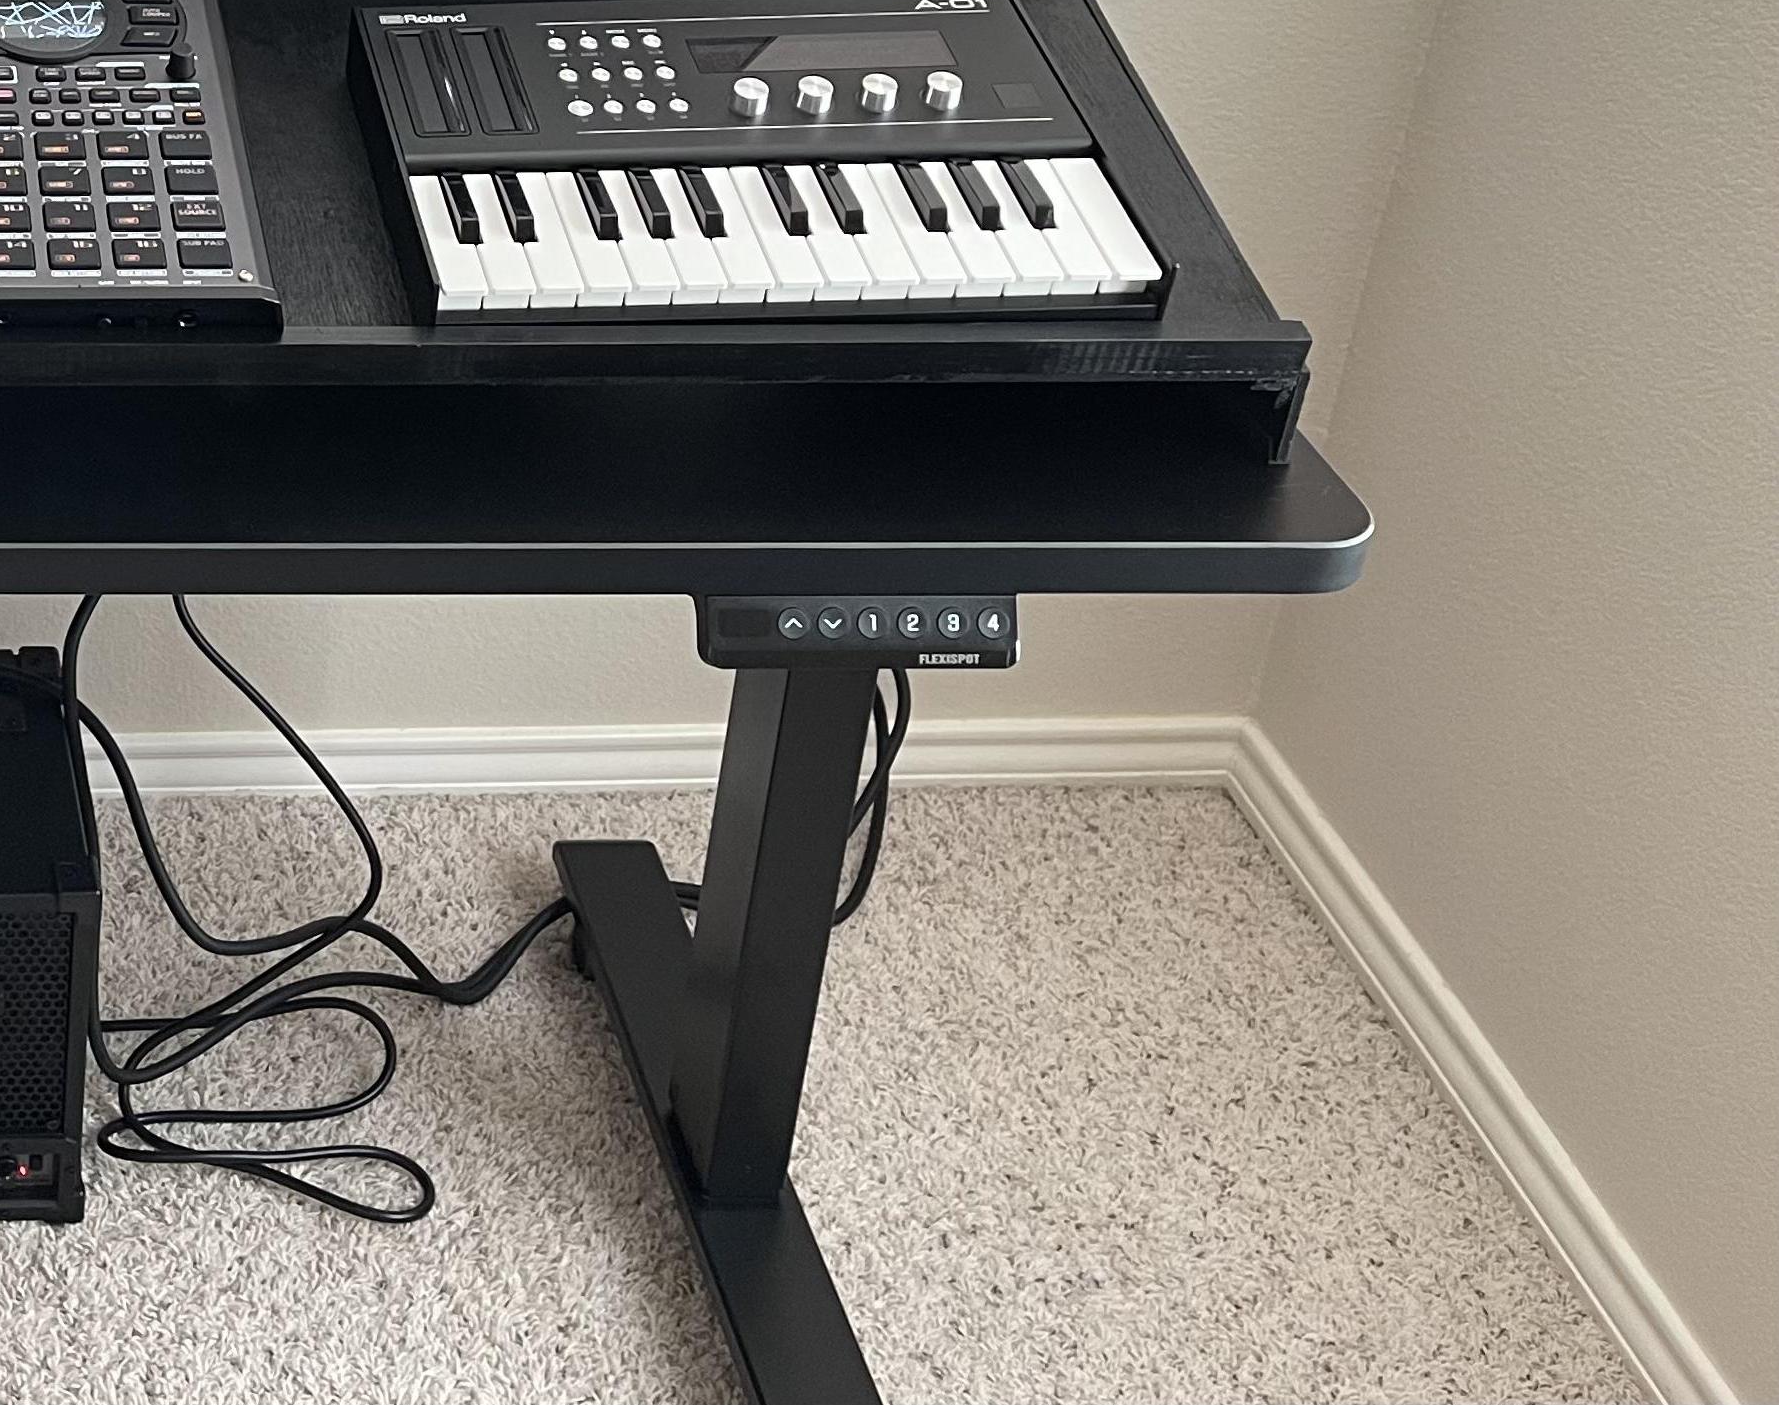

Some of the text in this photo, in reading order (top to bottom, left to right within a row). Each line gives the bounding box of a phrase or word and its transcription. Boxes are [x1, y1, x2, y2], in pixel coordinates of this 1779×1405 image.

[404, 13, 466, 24] Roland
[869, 614, 1000, 631] 1 2 3 4
[919, 653, 980, 665] FLEXISPOT
